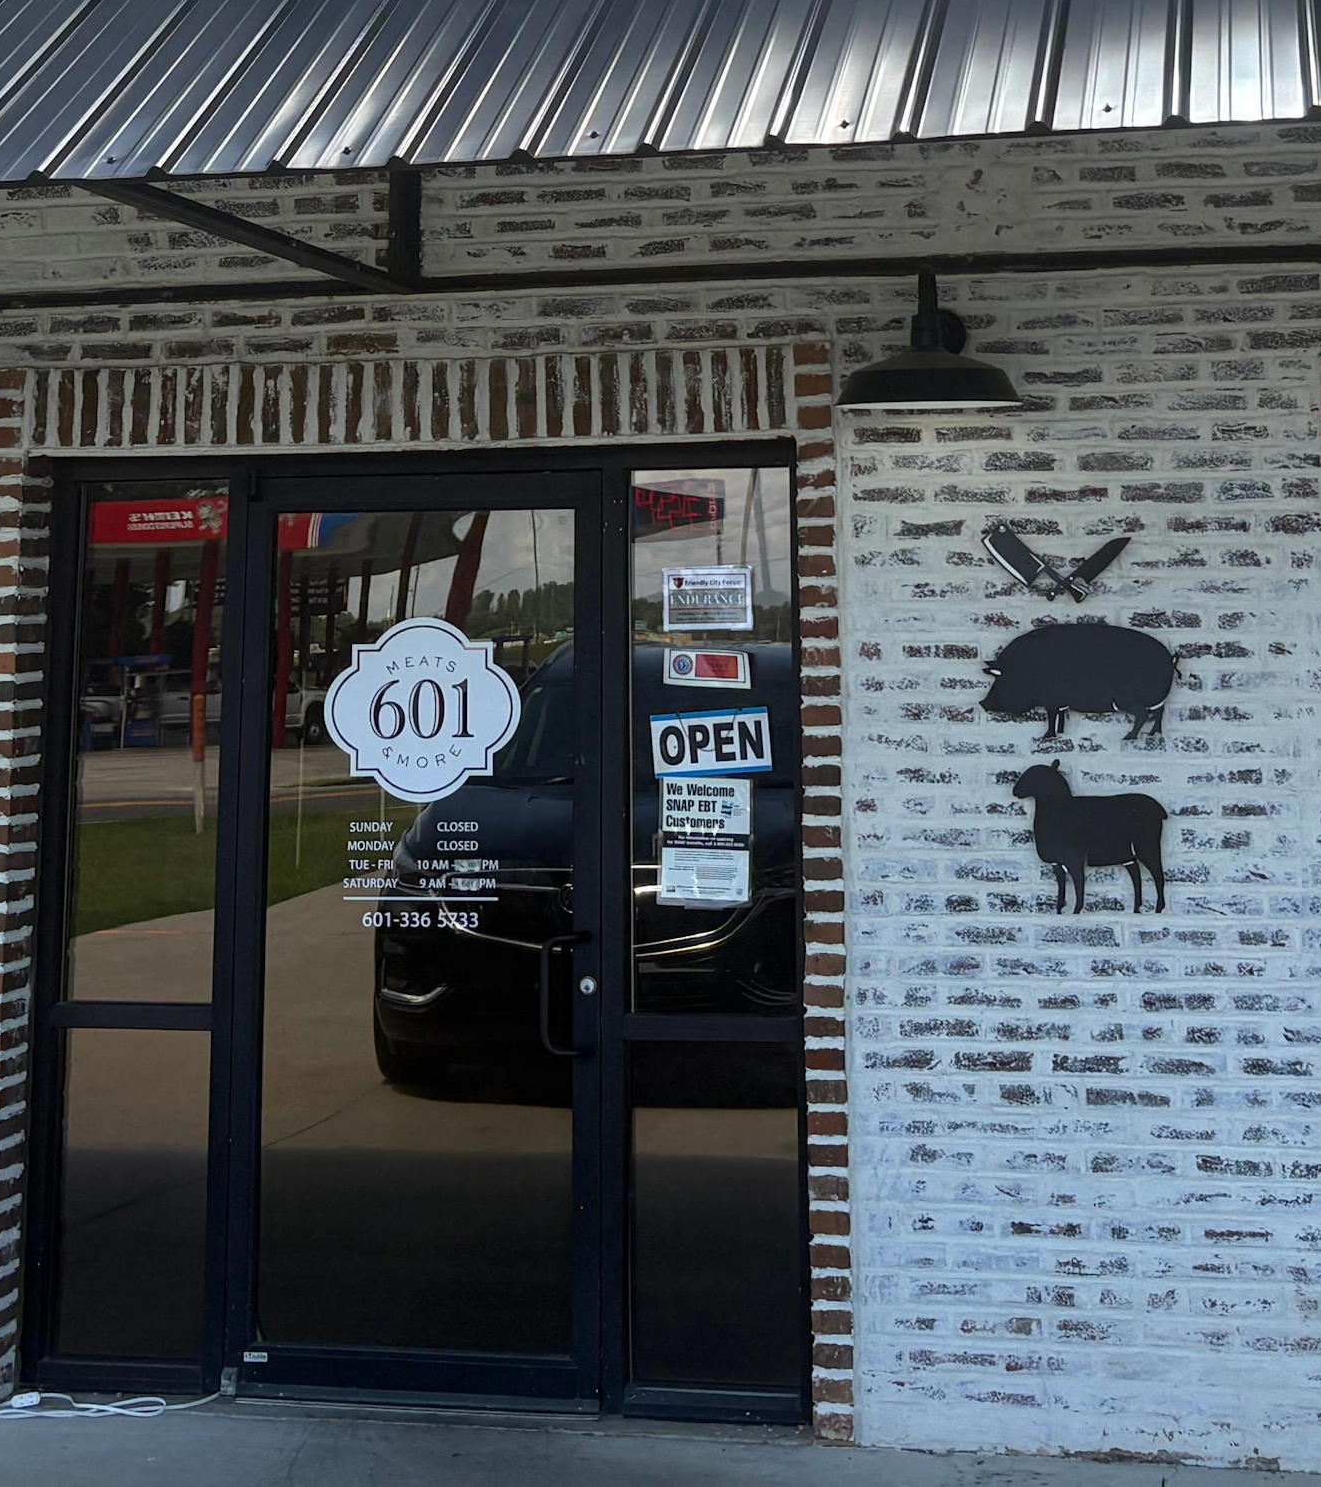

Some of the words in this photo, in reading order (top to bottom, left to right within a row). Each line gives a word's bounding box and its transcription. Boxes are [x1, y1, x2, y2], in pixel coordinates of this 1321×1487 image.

[669, 593, 743, 606] ENDURANCE
[386, 656, 458, 675] MEATS
[369, 678, 475, 739] 601
[659, 720, 765, 766] OPEN
[396, 744, 462, 768] MORE
[666, 783, 683, 796] We
[686, 783, 735, 798] Welcome
[666, 798, 695, 812] SNAP
[698, 800, 717, 813] EBT
[349, 821, 393, 832] SUNDAY
[436, 821, 479, 832] CLOSED
[666, 814, 725, 829] Customers
[347, 840, 395, 851] MONDAY
[436, 840, 479, 851] CLOSED
[349, 859, 370, 870] TUE
[377, 859, 394, 870] FRI
[417, 859, 430, 870] 10
[431, 859, 449, 870] AM
[482, 859, 499, 870] PM
[343, 878, 399, 889] SATURDAY
[419, 878, 426, 889] 9
[428, 878, 446, 889] AM
[479, 878, 496, 889] PM
[362, 912, 431, 928] 601-336
